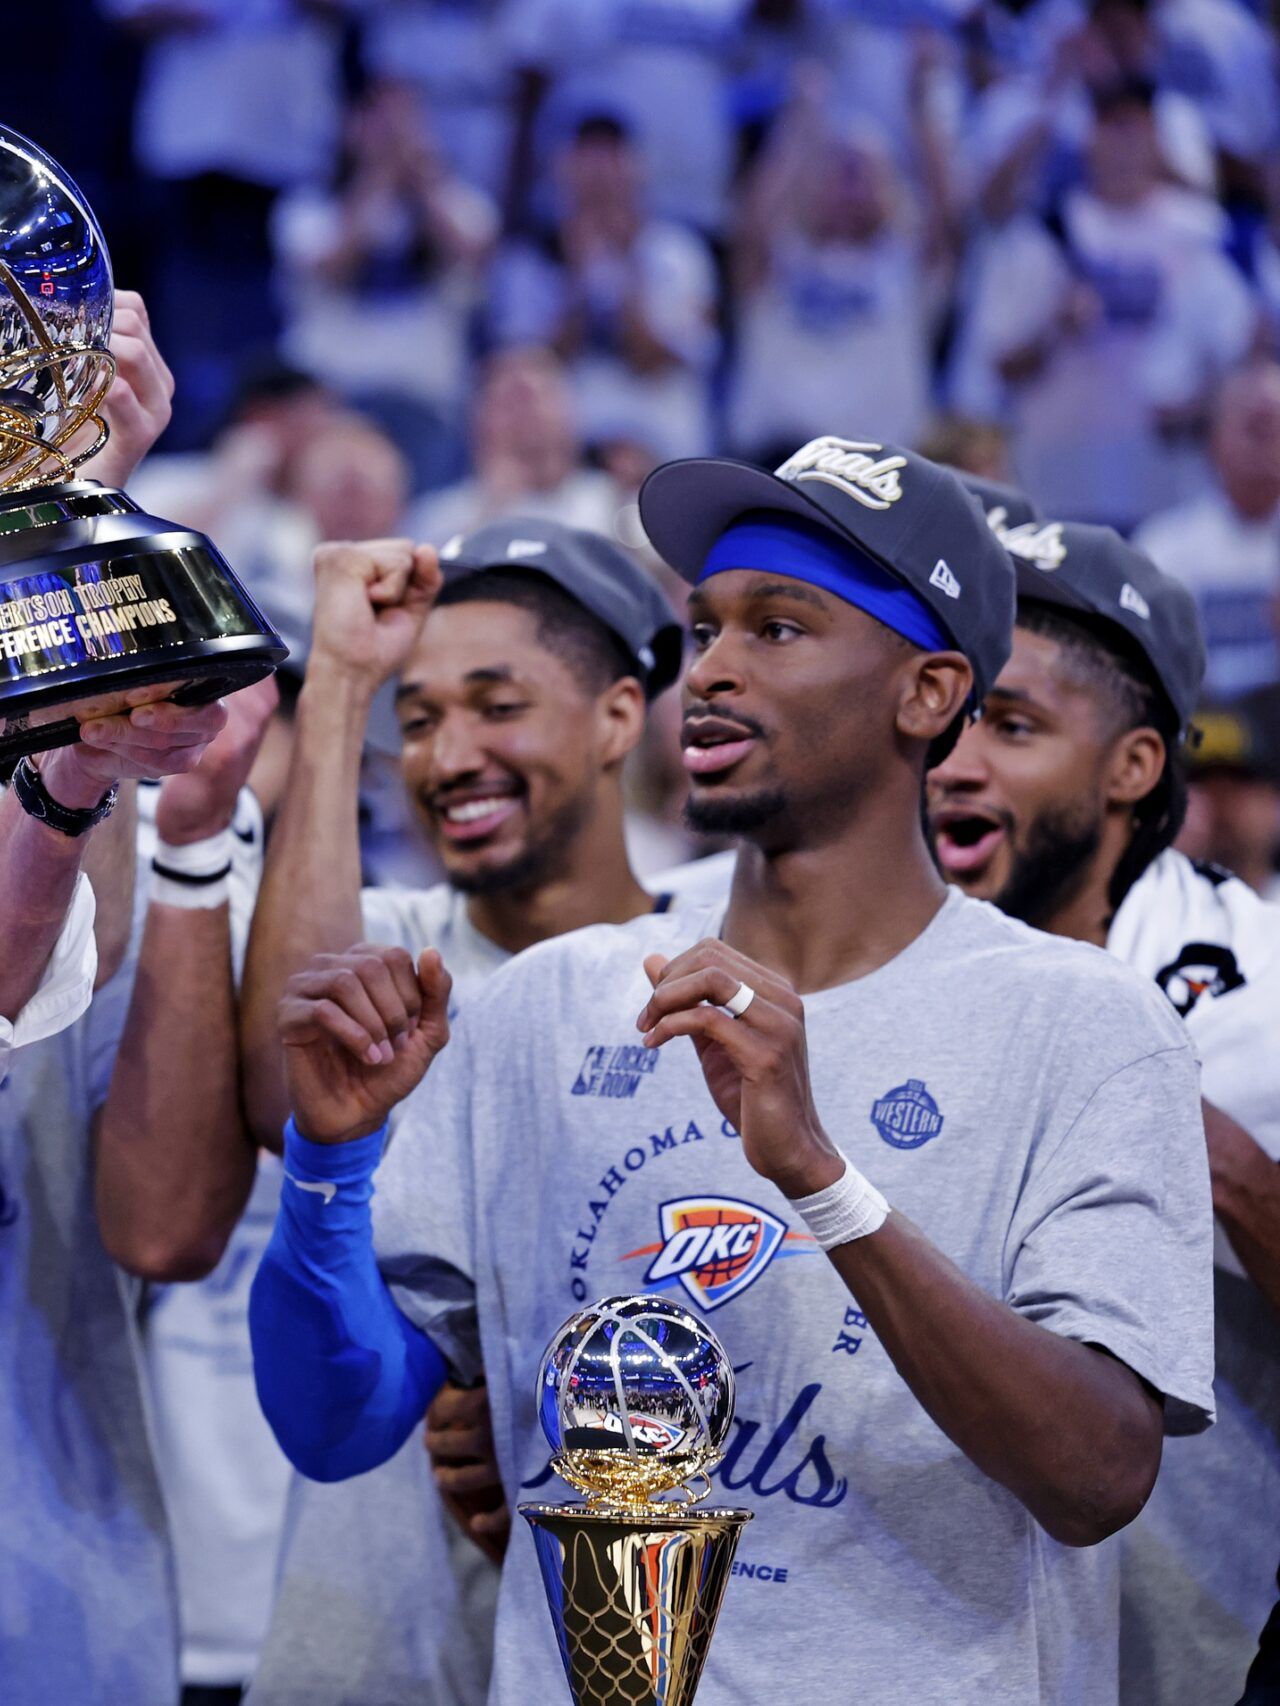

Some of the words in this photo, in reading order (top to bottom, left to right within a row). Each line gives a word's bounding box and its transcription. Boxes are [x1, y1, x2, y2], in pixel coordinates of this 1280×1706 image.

[73, 573, 148, 610] TROPHY
[75, 597, 178, 639] CHAMPIONS
[874, 1101, 941, 1133] WESTERN
[571, 1120, 705, 1301] OKLAHOMA
[648, 1222, 761, 1281] OKC
